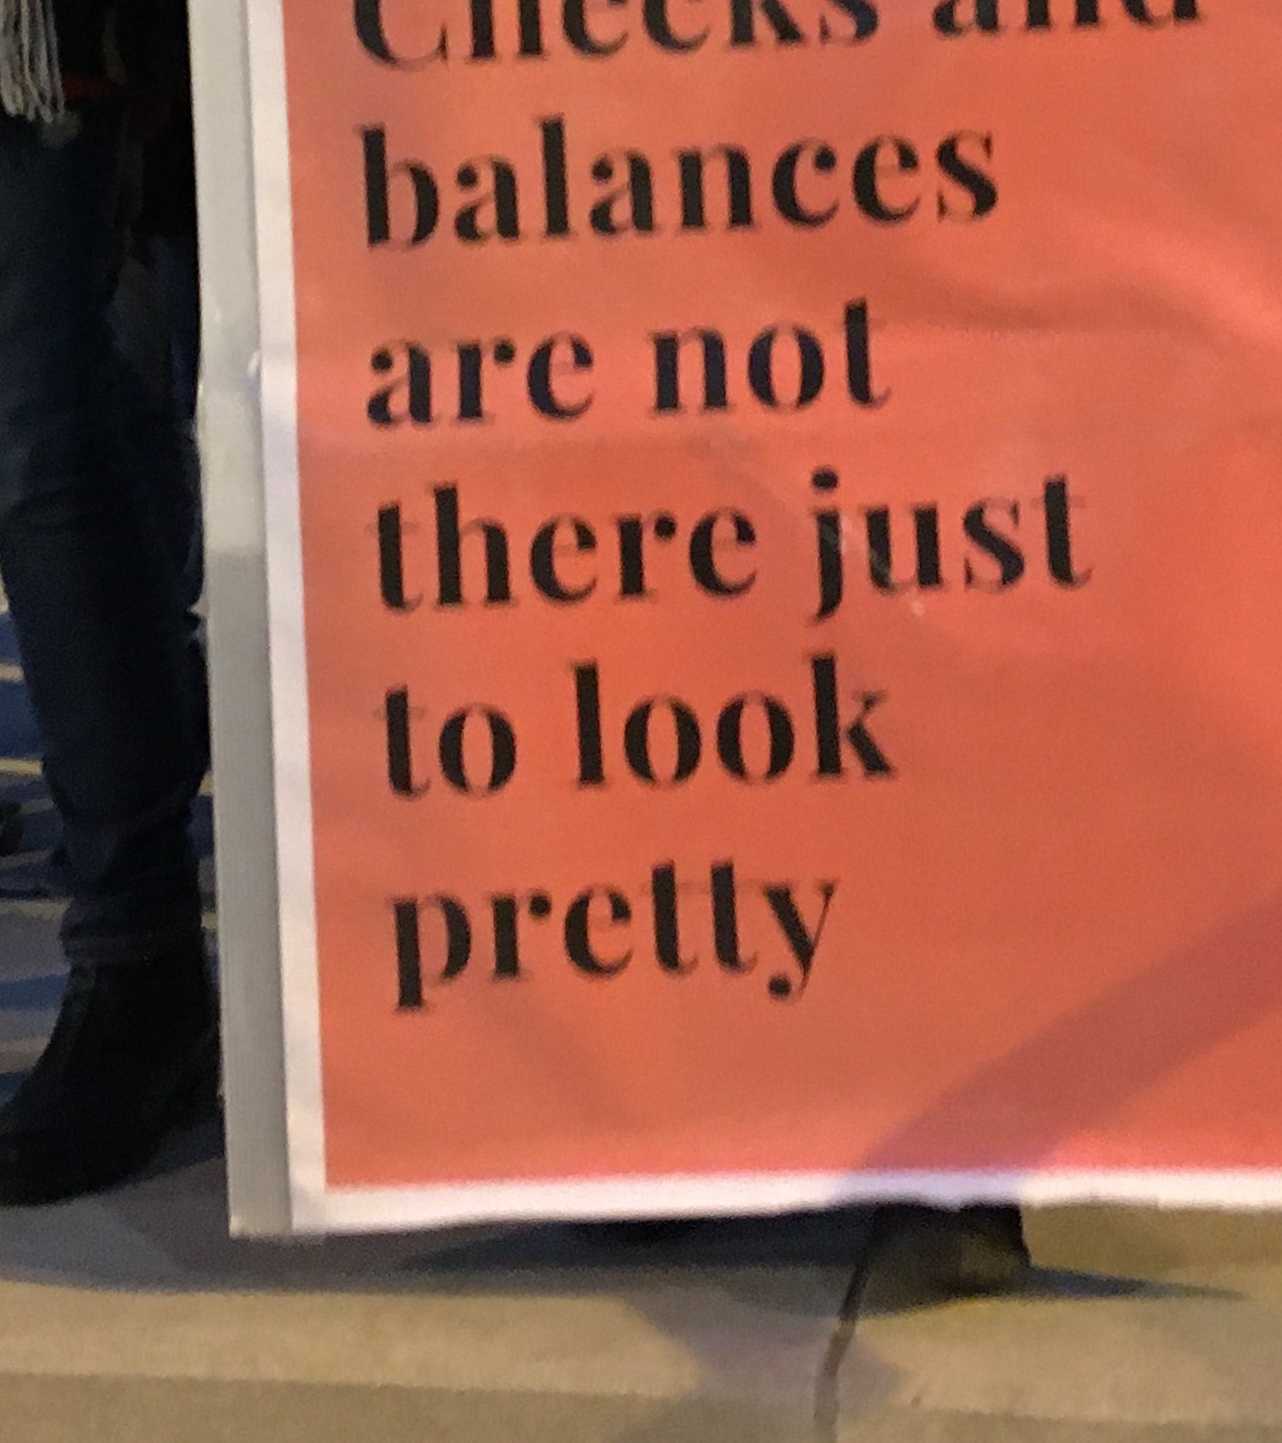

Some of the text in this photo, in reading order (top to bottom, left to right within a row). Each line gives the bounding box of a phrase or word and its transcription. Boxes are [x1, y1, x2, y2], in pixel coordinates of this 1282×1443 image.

[356, 116, 1002, 250] balances
[365, 297, 894, 431] are not
[370, 465, 1097, 621] there just
[375, 651, 900, 798] to look
[388, 858, 841, 1015] pretty
